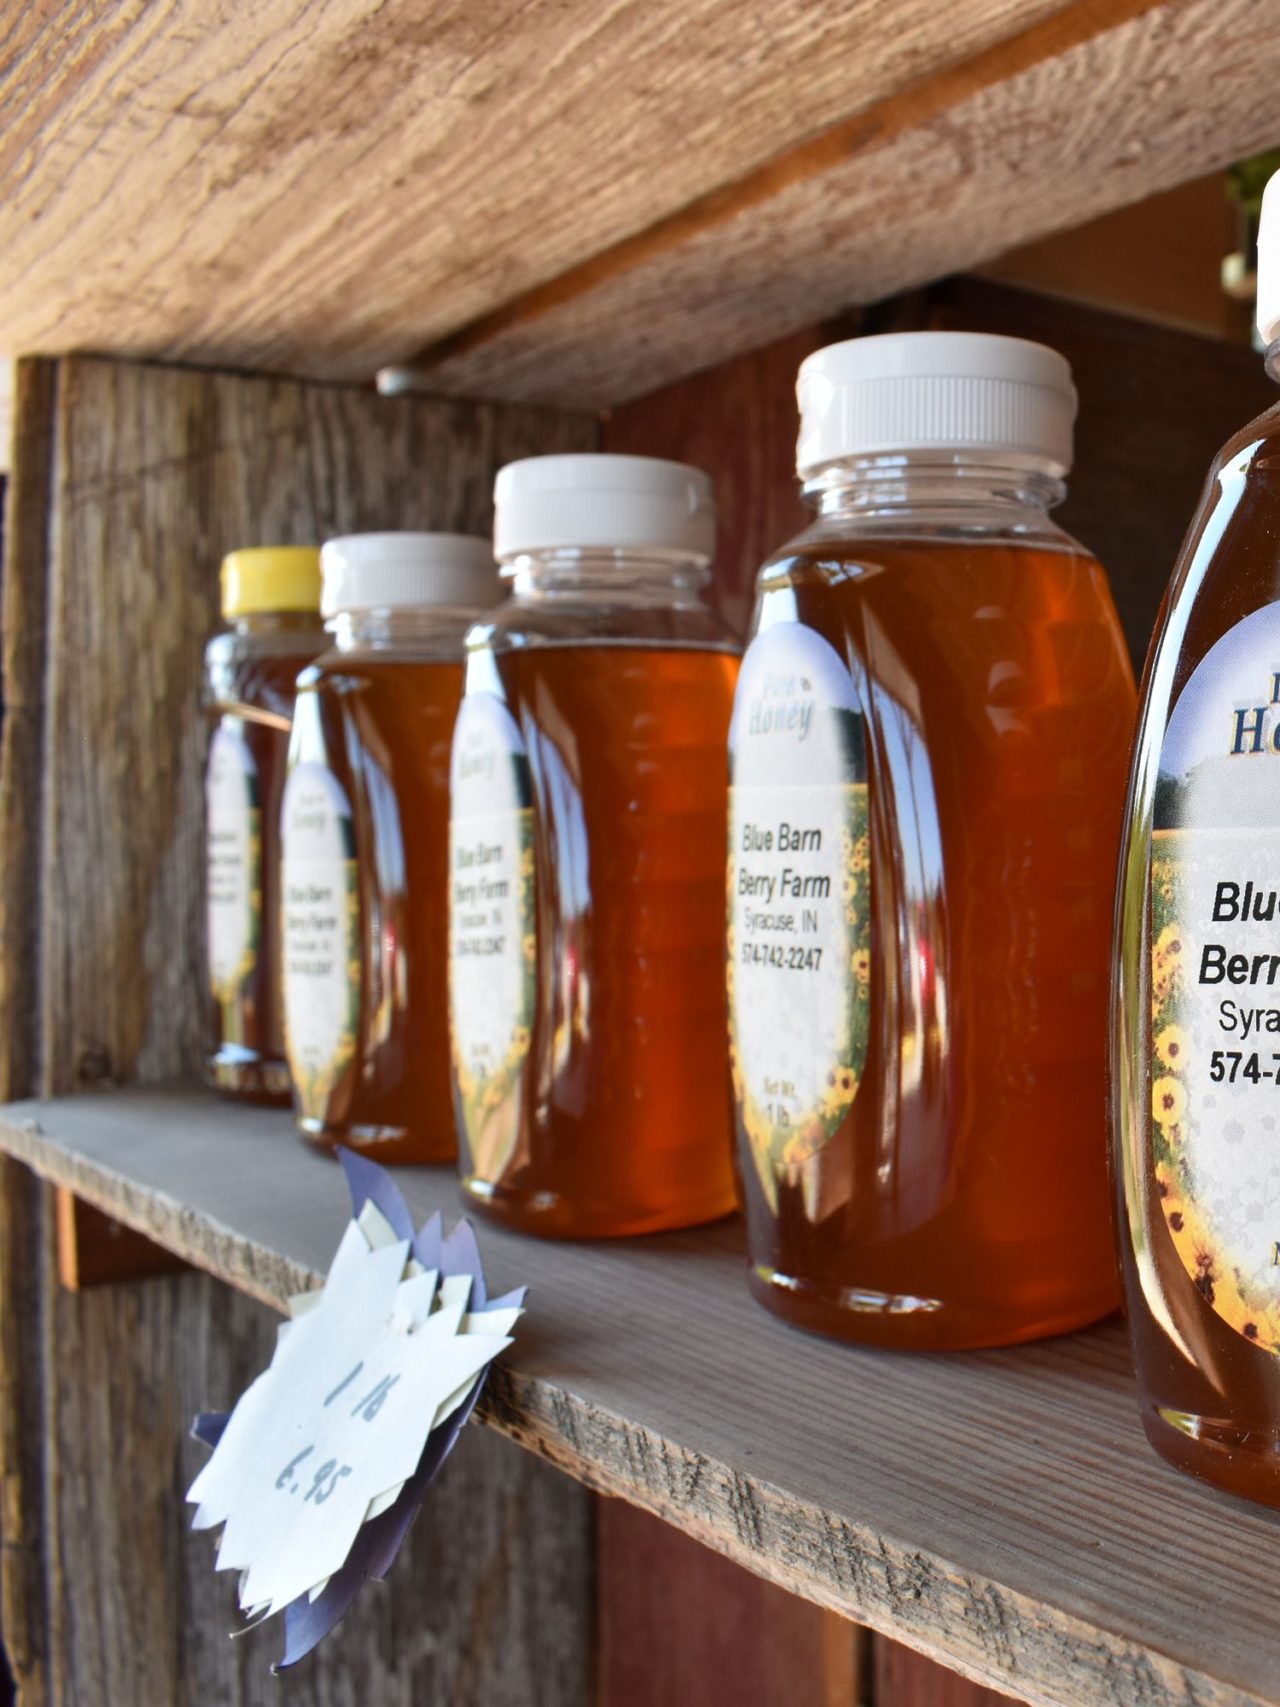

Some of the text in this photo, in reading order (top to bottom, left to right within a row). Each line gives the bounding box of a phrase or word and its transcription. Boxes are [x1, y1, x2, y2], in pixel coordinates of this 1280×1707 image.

[742, 822, 822, 852] Blue Barn
[738, 867, 831, 904] Berry Farm
[802, 909, 818, 933] IN
[275, 1443, 353, 1506] 6.95
